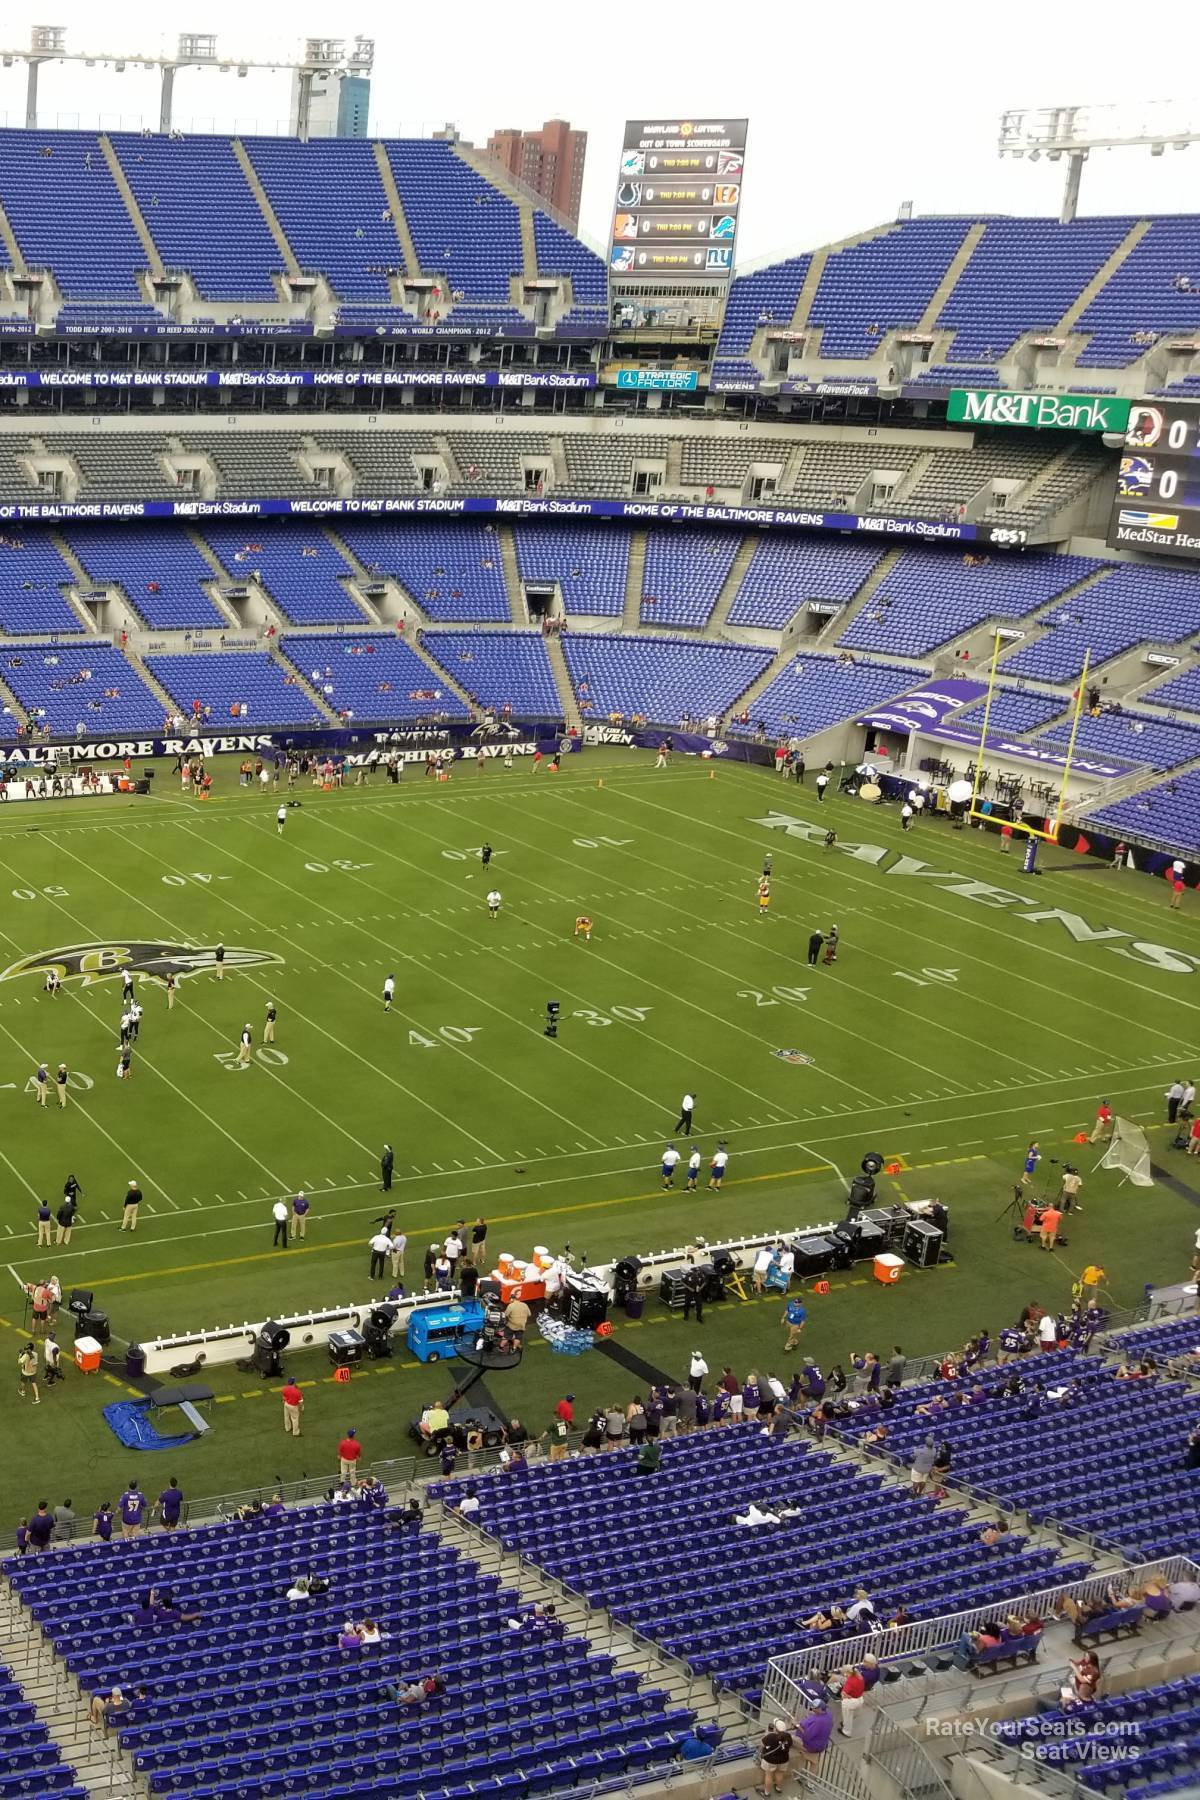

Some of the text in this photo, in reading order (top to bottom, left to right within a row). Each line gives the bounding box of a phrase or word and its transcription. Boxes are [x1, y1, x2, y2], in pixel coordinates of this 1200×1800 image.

[40, 374, 207, 385] WELCOME TO M&T BANK STADIUM
[219, 374, 303, 385] M&T Bank Stadium
[314, 374, 486, 384] HOME OF THE BALTIMORE RAVENS
[498, 374, 589, 386] M&T Bank Stadium
[637, 379, 690, 389] FACTORY
[638, 371, 691, 381] STRATEGIC
[816, 384, 869, 395] #RavensFlock
[962, 392, 1110, 429] M&T Bank
[1168, 420, 1188, 449] 0
[1159, 470, 1178, 499] 0
[0, 507, 15, 518] OF
[18, 507, 39, 518] THE
[41, 505, 101, 516] BALTIMORE
[103, 504, 144, 515] RAVENS
[290, 501, 464, 512] WELCOME TO M&T BANK STADIUM
[624, 505, 823, 525] HOME OF THE BALTIMORE RAVENS
[857, 517, 960, 537] M&T Bank Stadium
[1116, 527, 1175, 545] MedStar
[161, 735, 273, 754] RAVENS
[461, 743, 537, 759] RAVENS
[998, 743, 1120, 774] RAVENS
[303, 858, 362, 874] 30
[11, 884, 70, 901] 50
[745, 810, 1200, 973] RAVENS
[736, 986, 809, 1008] 20
[572, 1004, 646, 1027] 30
[408, 1026, 473, 1048] 40
[213, 1047, 289, 1071] 50
[1004, 1338, 1017, 1348] 95
[339, 1370, 350, 1381] 40
[127, 1500, 140, 1512] 57
